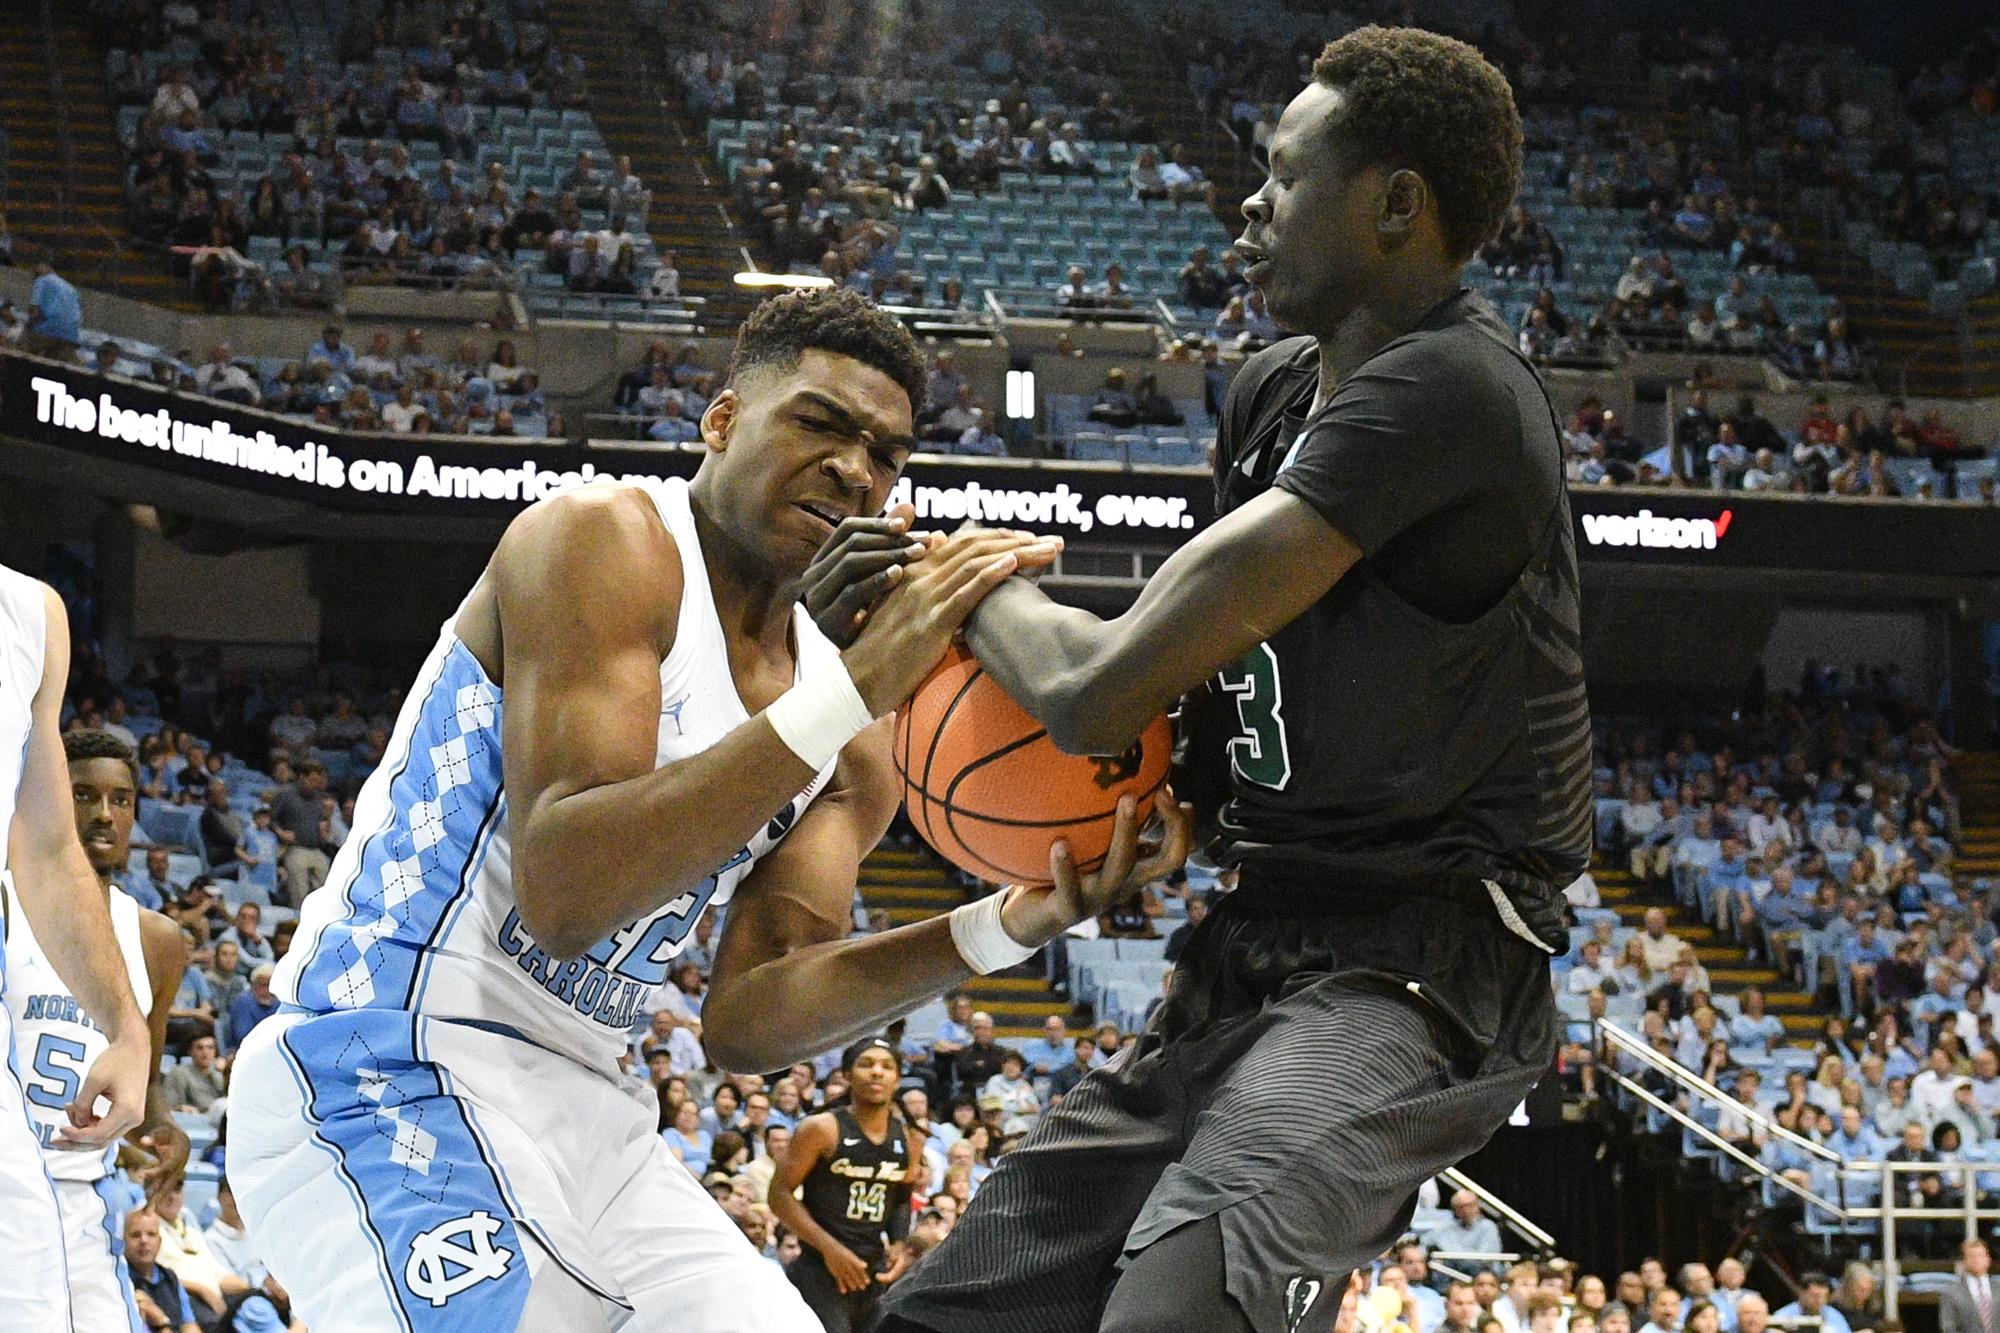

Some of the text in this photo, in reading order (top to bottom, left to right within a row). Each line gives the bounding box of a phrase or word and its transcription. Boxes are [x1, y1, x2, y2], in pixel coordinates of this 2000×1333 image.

[31, 376, 97, 432] The
[99, 394, 171, 450] best
[172, 420, 315, 483] unlimited
[317, 445, 345, 488] is
[349, 458, 403, 494] on
[915, 481, 1093, 532] network,
[1096, 494, 1194, 529] ever.
[1581, 509, 1717, 549] verizon
[23, 995, 105, 1031] NOR
[26, 1033, 86, 1110] 5
